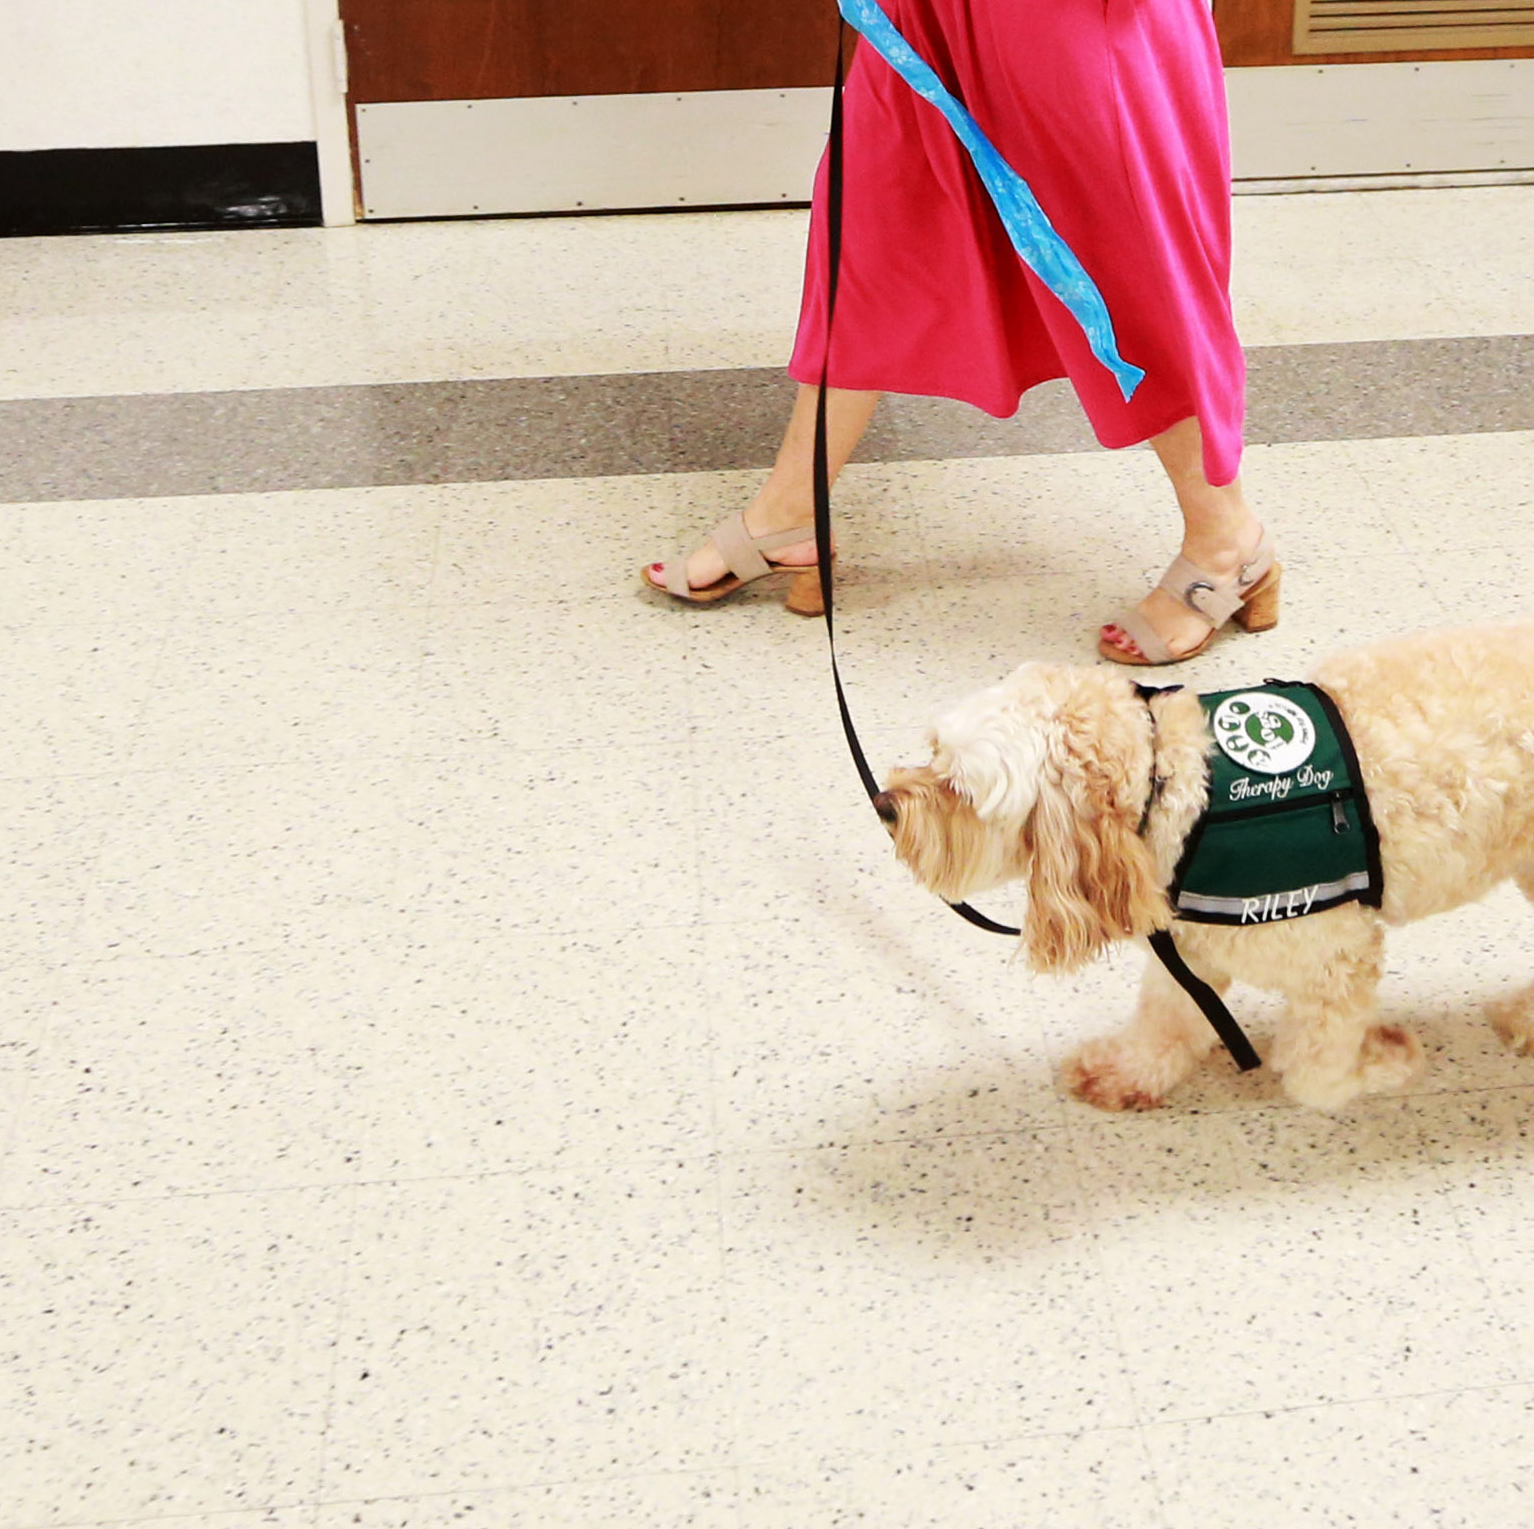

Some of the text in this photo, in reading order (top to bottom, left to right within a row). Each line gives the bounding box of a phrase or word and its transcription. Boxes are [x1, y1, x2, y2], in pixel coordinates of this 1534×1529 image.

[1229, 764, 1334, 801] Therapy Dog
[1241, 885, 1319, 924] RILEY
